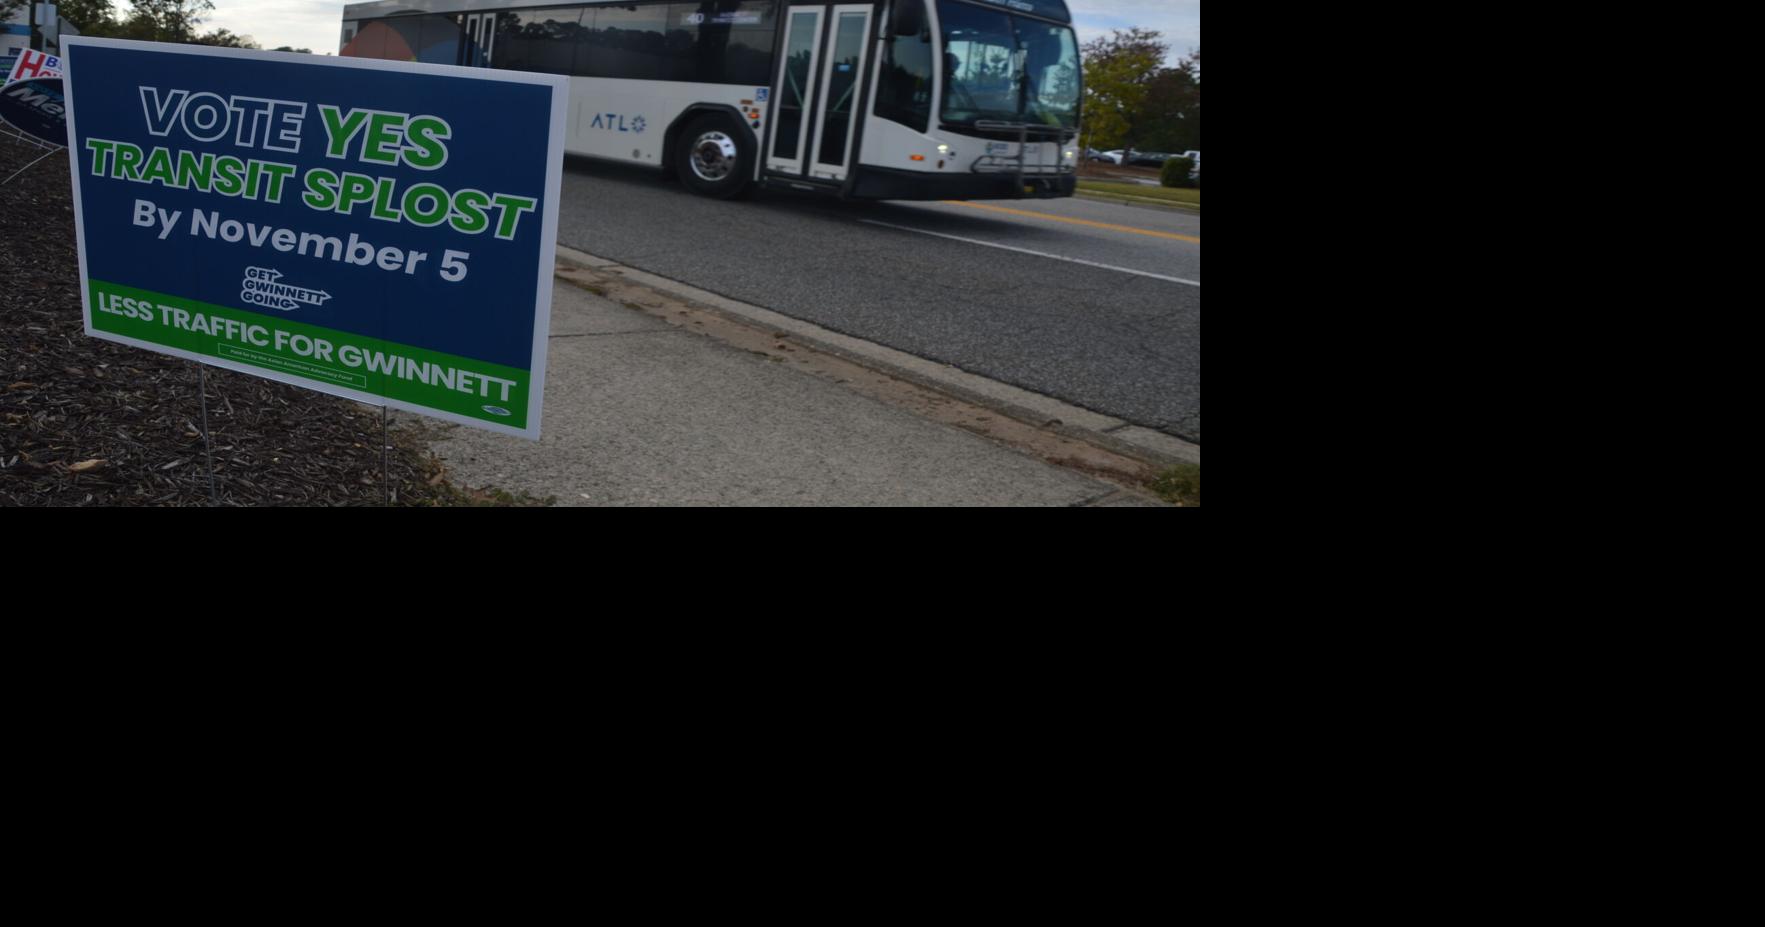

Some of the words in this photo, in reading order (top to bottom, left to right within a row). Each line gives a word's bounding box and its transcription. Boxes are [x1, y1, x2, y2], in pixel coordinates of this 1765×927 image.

[138, 86, 308, 154] VOTE
[317, 103, 452, 171] YES
[590, 112, 628, 131] ATL
[86, 137, 297, 204] TRANSIT
[302, 167, 538, 241] SPLOST
[132, 199, 182, 240] By
[190, 208, 428, 276] November
[439, 249, 470, 282] 5
[242, 290, 292, 309] GOING
[243, 279, 324, 304] GWINNETT
[246, 267, 277, 282] GET
[98, 291, 154, 322] LESS
[157, 304, 270, 347] TRAFFIC
[274, 329, 334, 363] FOR
[338, 345, 517, 402] GWINNETT
